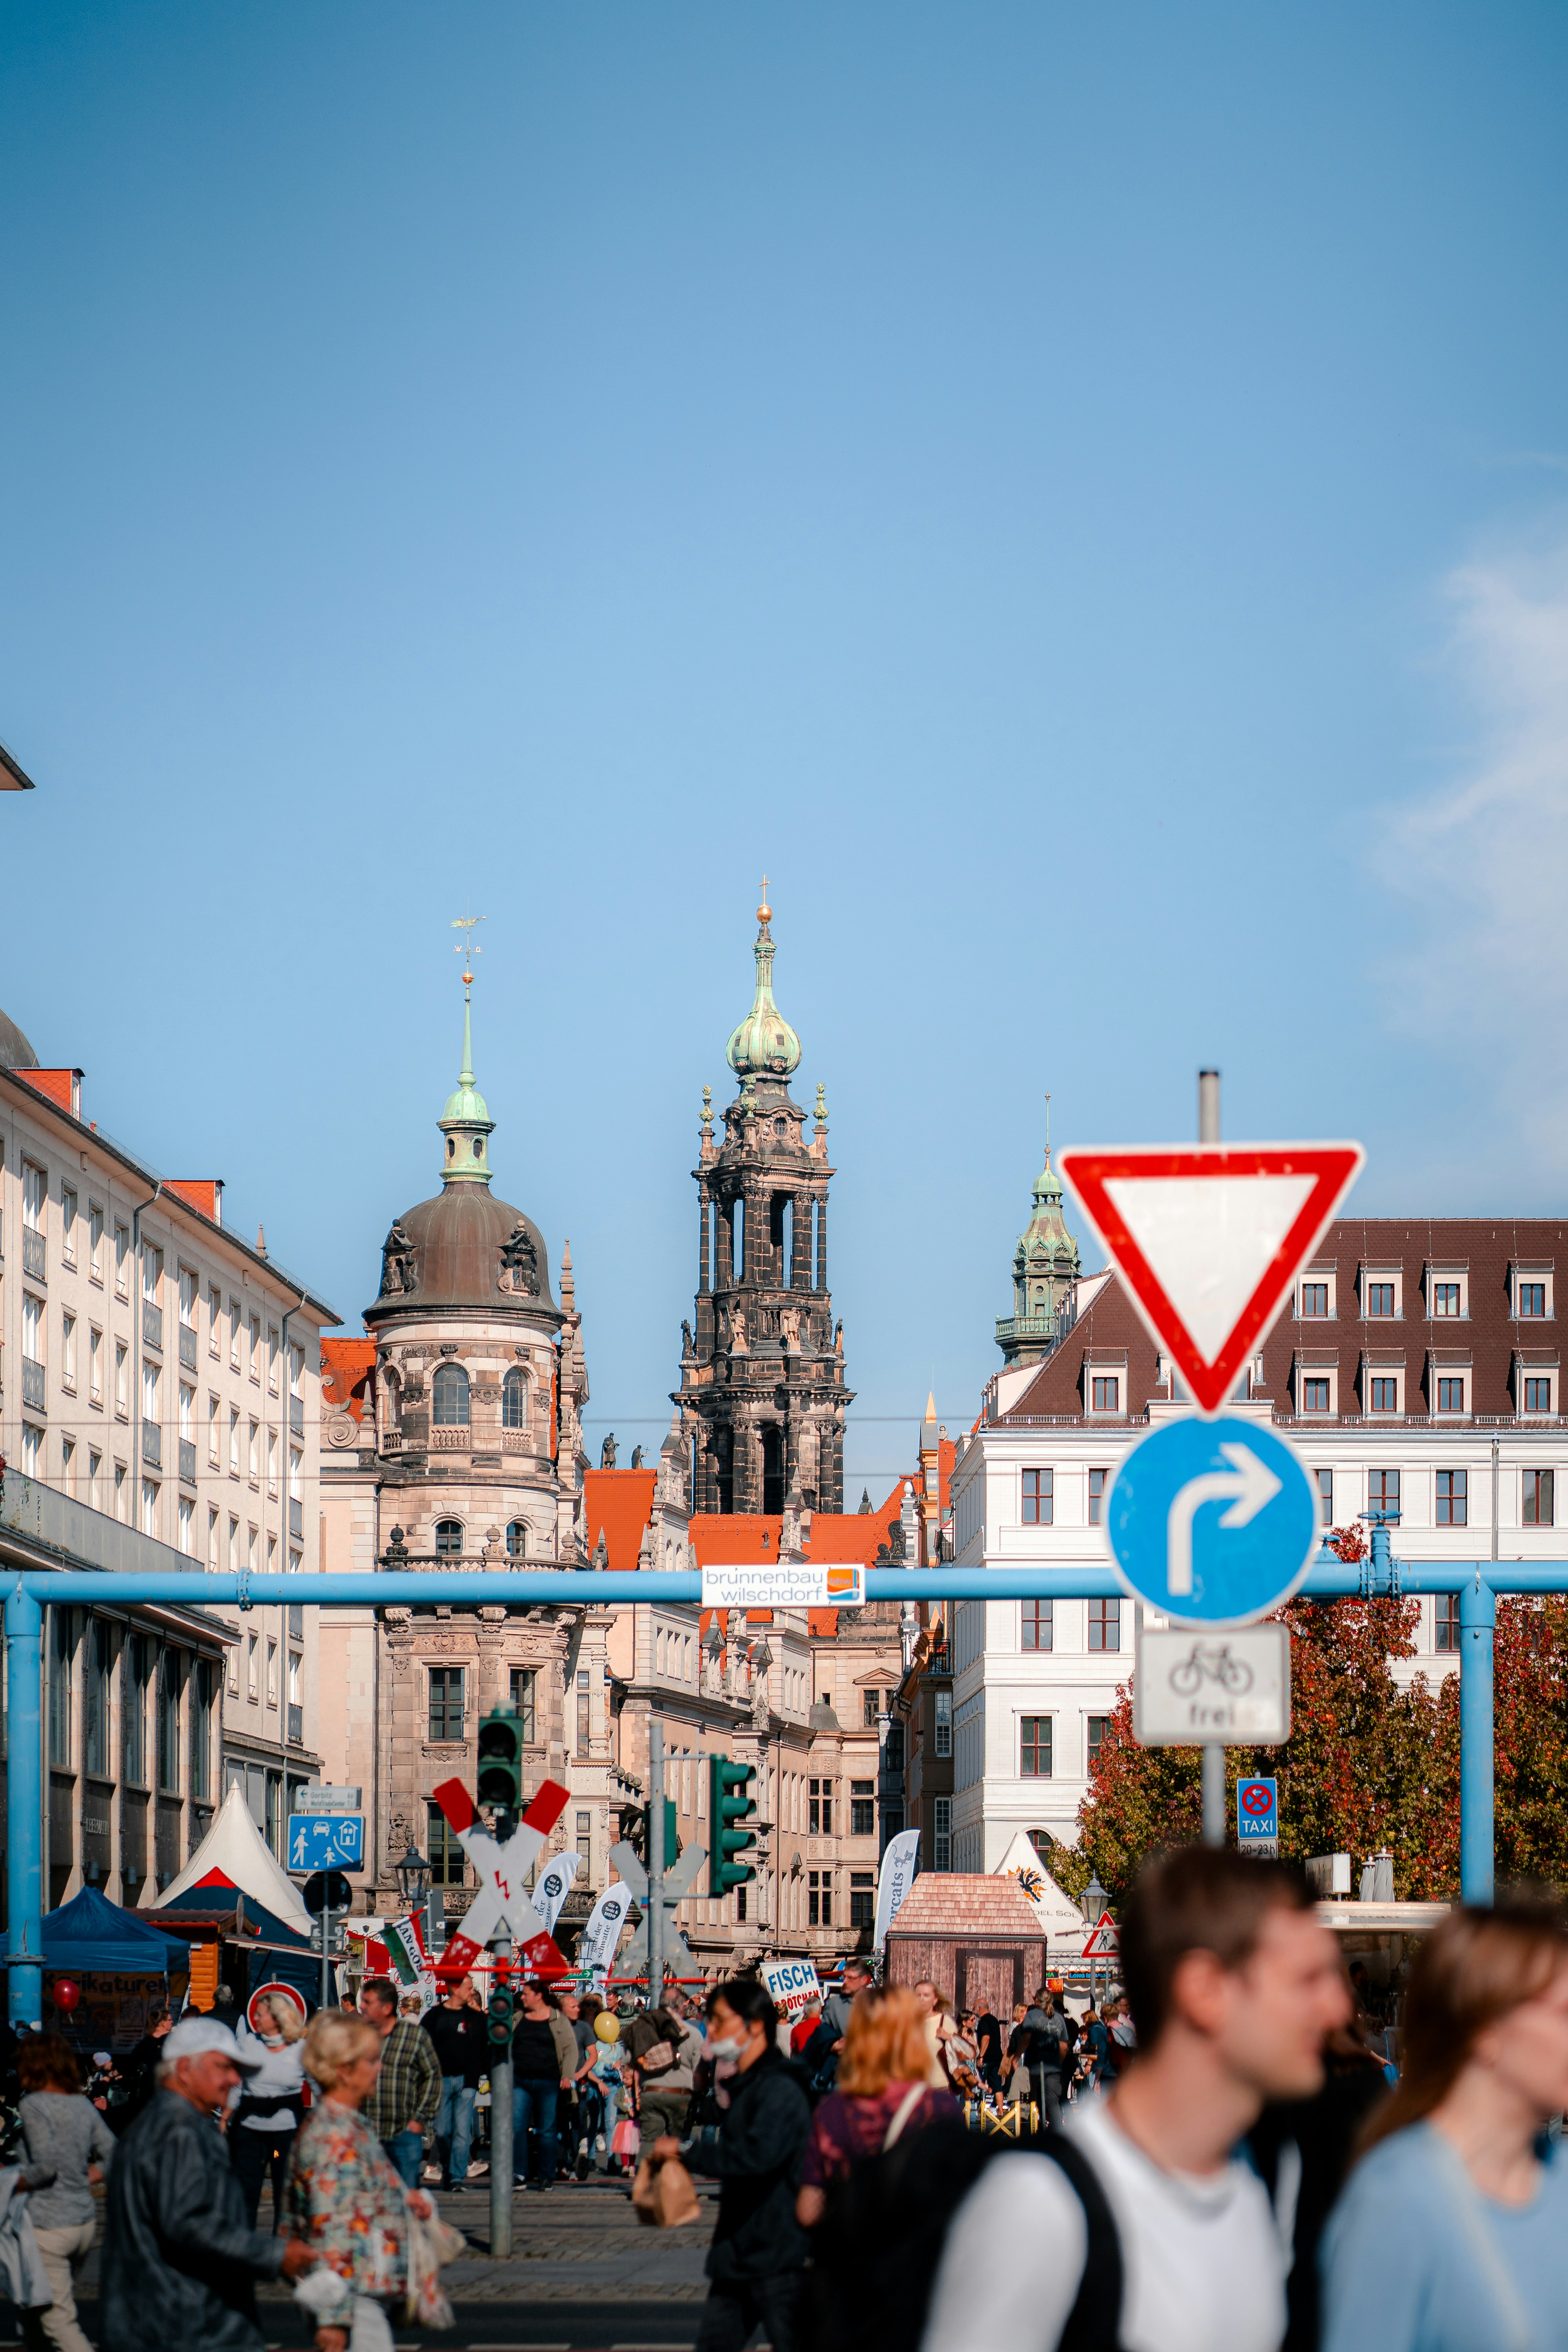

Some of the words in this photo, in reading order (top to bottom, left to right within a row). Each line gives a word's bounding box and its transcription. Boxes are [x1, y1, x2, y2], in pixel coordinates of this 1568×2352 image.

[706, 1570, 823, 1584] brunnenbau
[721, 1586, 822, 1601] wilschdorf
[1242, 1820, 1273, 1833] TAXI
[537, 1900, 545, 1916] der
[594, 1922, 603, 1936] der
[597, 1925, 611, 1959] schwatte
[768, 1965, 815, 1993] FISCH
